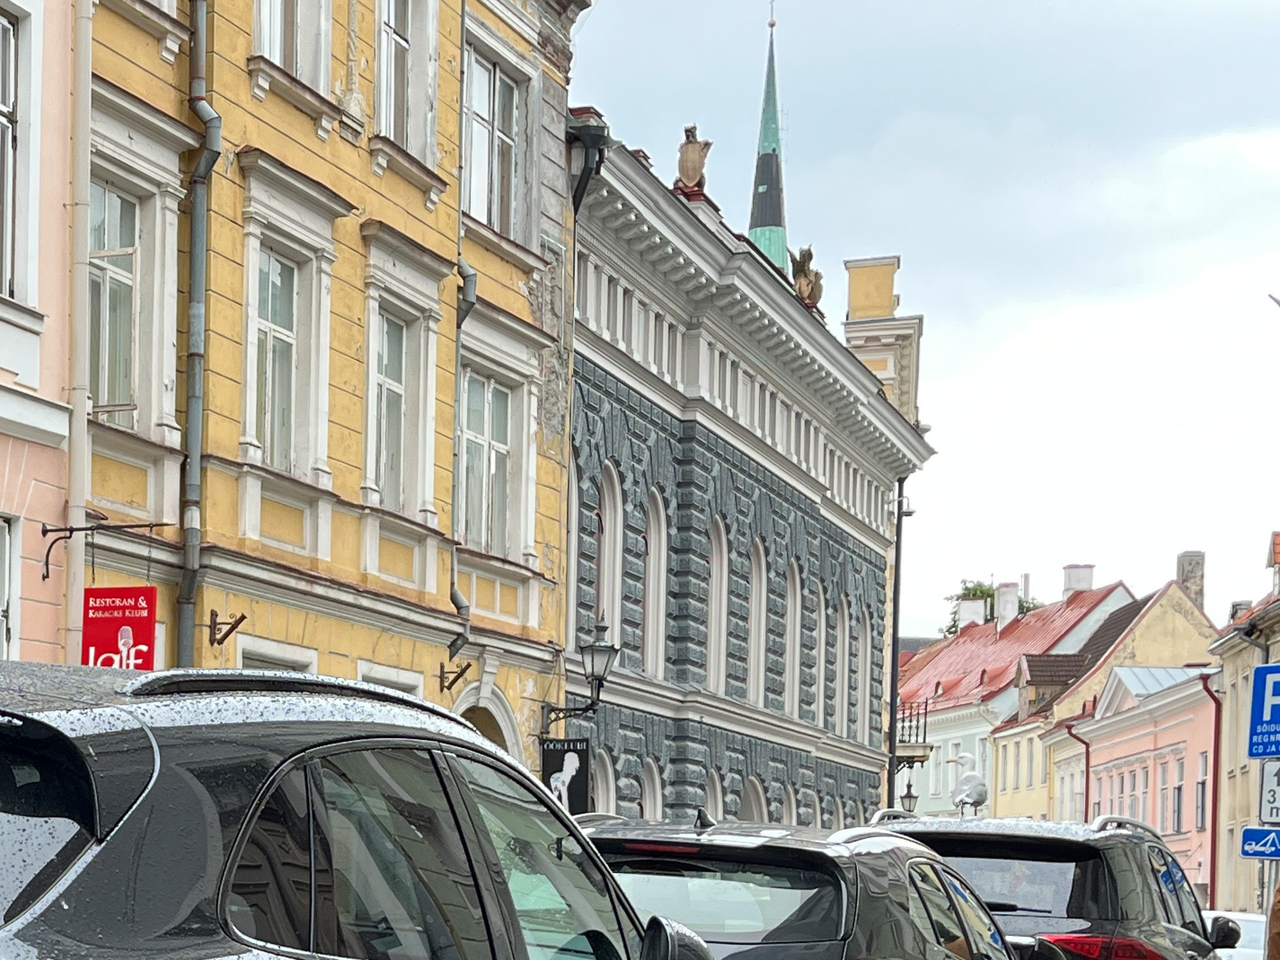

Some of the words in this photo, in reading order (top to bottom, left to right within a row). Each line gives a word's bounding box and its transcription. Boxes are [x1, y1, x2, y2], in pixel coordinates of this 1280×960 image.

[137, 595, 148, 608] &
[1252, 744, 1264, 753] CD
[1266, 744, 1277, 753] JA
